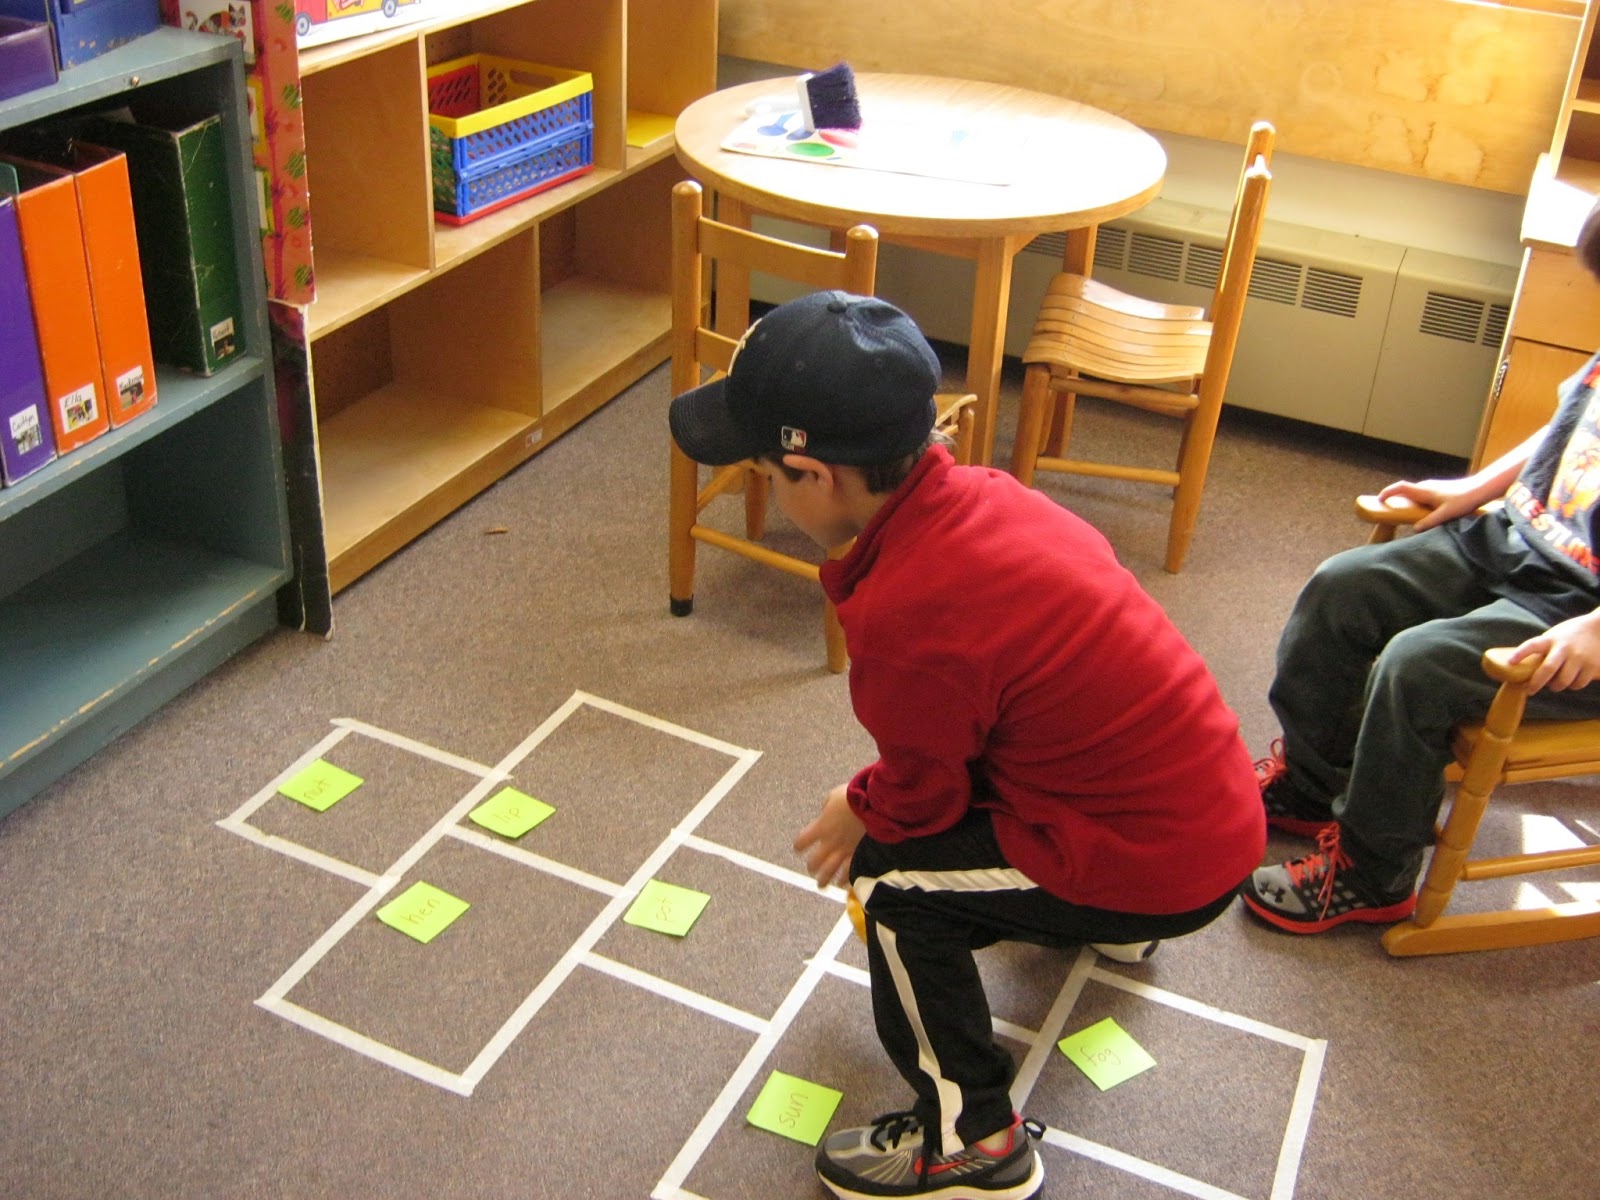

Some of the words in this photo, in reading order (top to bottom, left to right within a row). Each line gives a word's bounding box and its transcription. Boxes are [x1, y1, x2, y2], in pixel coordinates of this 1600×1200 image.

[1506, 481, 1600, 574] RESTLIN
[400, 898, 441, 925] hen
[1080, 1046, 1121, 1067] fog
[778, 1092, 809, 1129] sun
